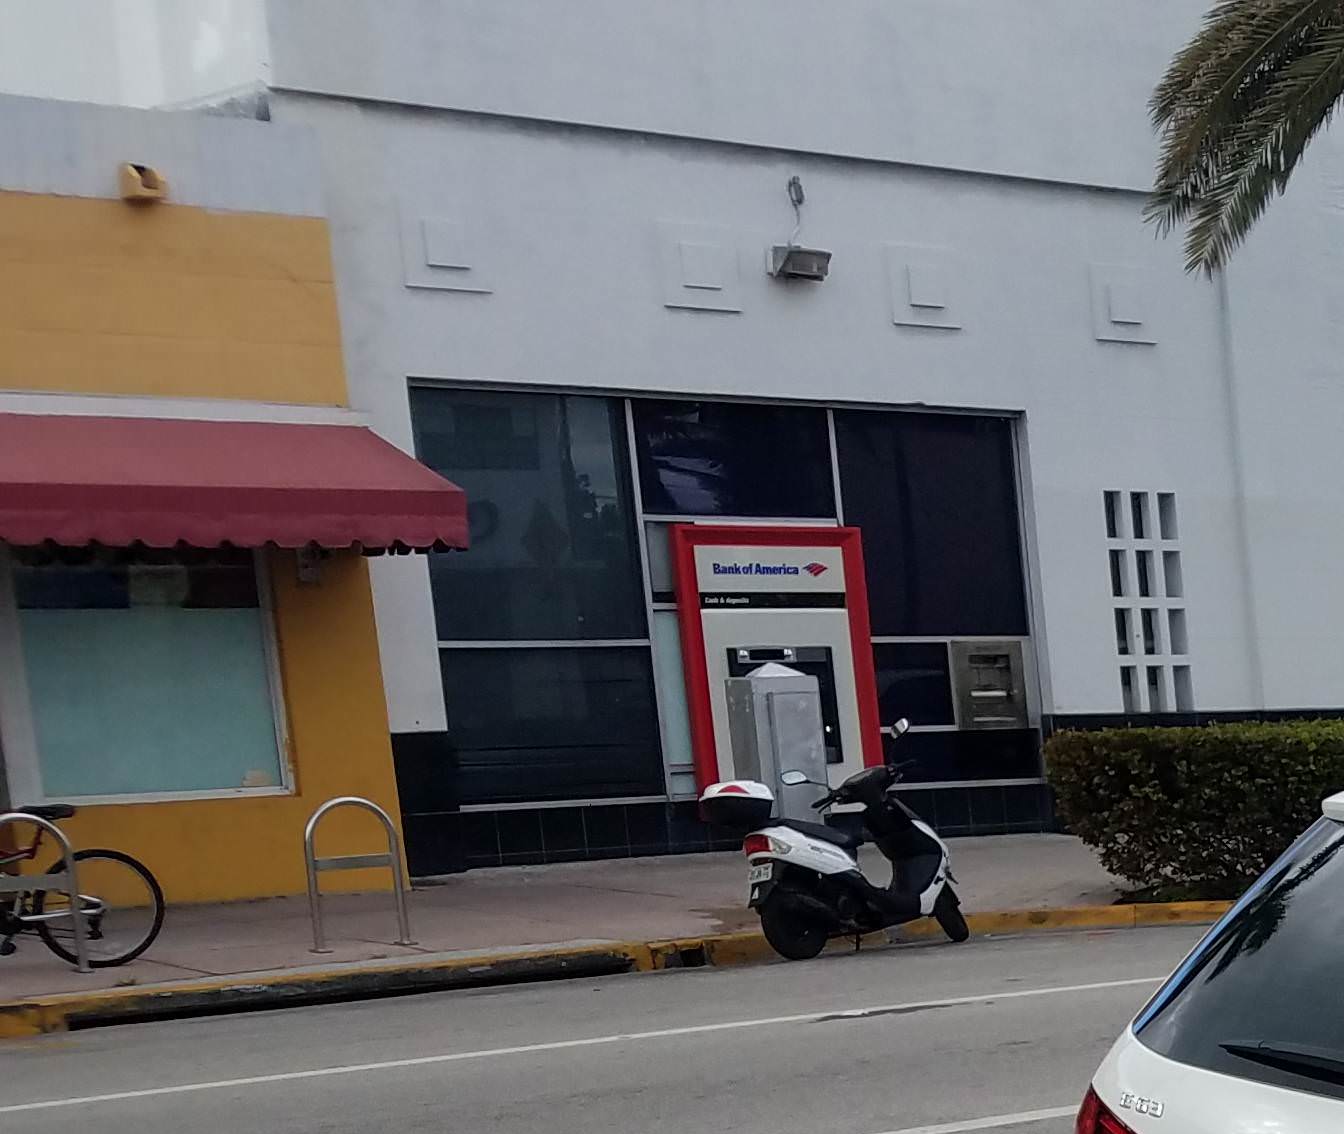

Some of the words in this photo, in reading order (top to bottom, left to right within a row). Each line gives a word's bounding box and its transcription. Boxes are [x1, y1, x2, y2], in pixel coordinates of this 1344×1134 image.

[712, 563, 742, 575] Bank
[742, 563, 753, 575] of
[754, 563, 799, 576] America
